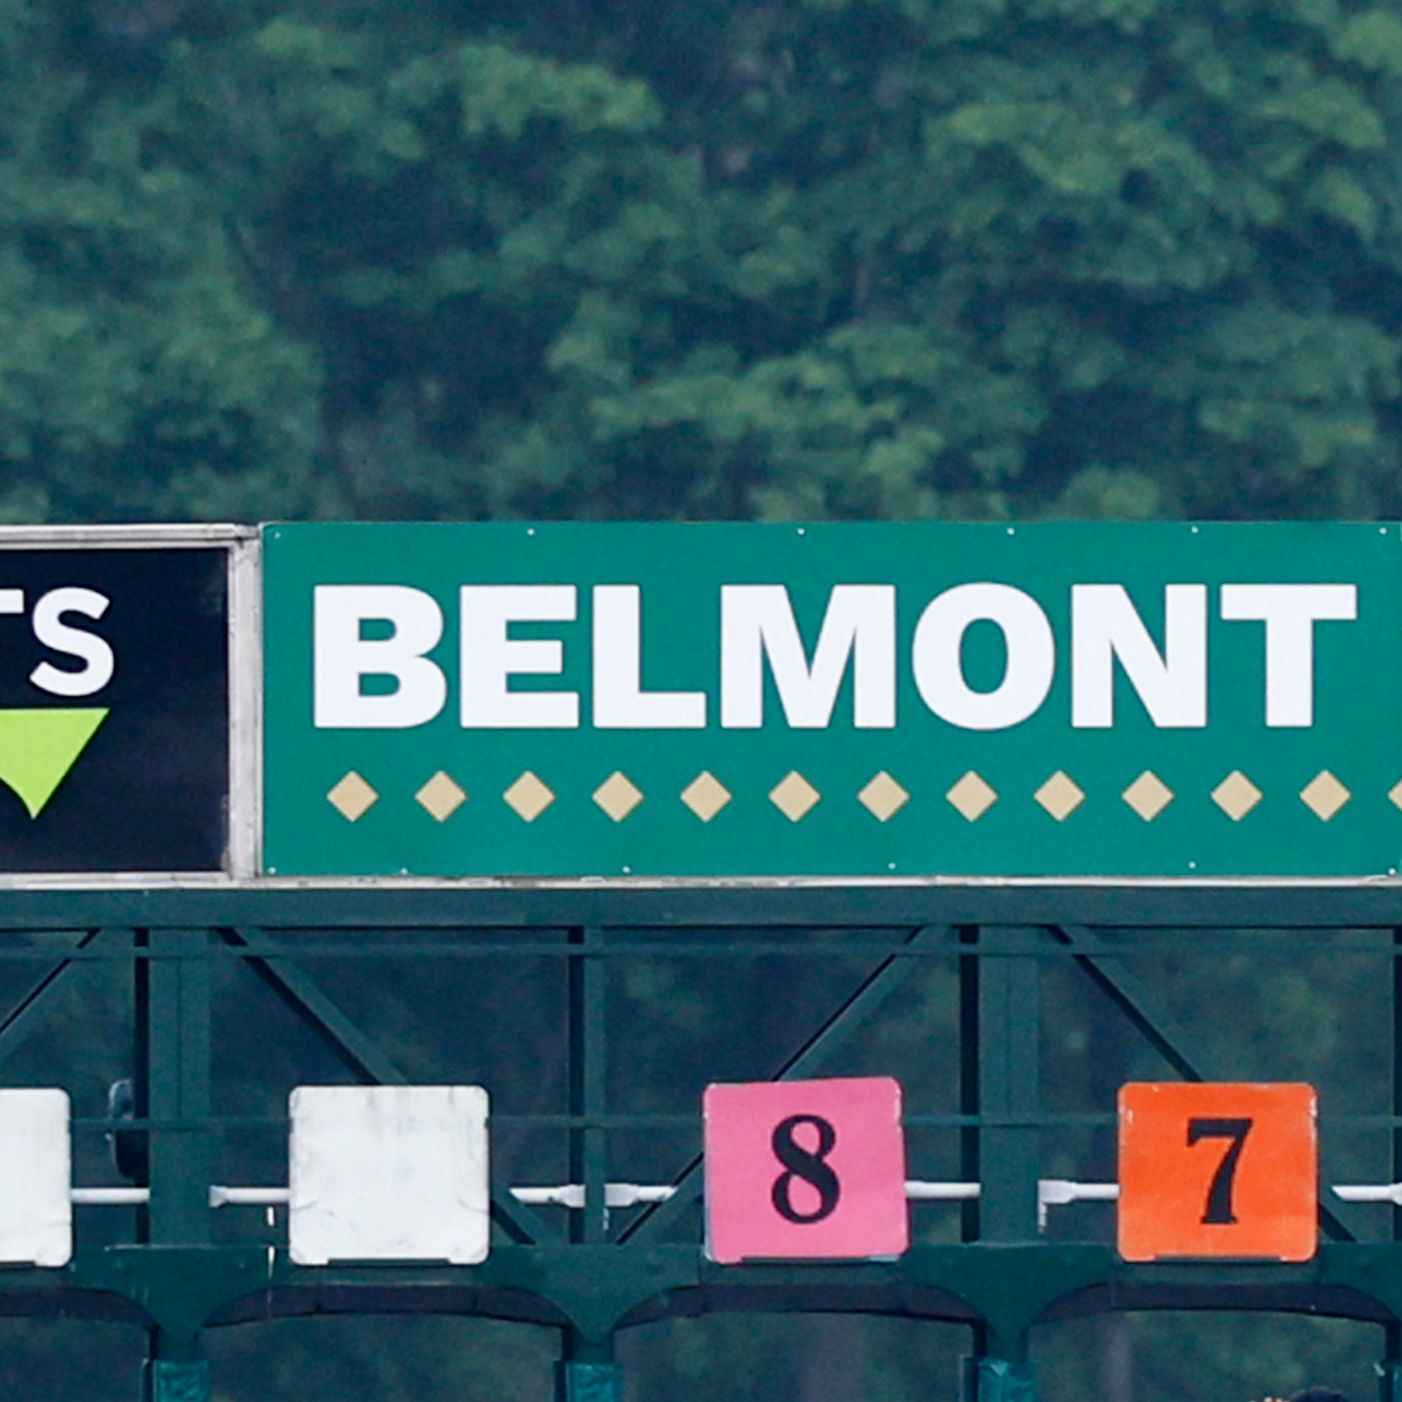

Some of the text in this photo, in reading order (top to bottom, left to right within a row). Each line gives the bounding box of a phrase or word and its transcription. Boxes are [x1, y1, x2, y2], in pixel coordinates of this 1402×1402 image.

[314, 582, 1357, 730] BELMONT
[772, 1115, 840, 1224] 8
[1187, 1118, 1253, 1225] 7
